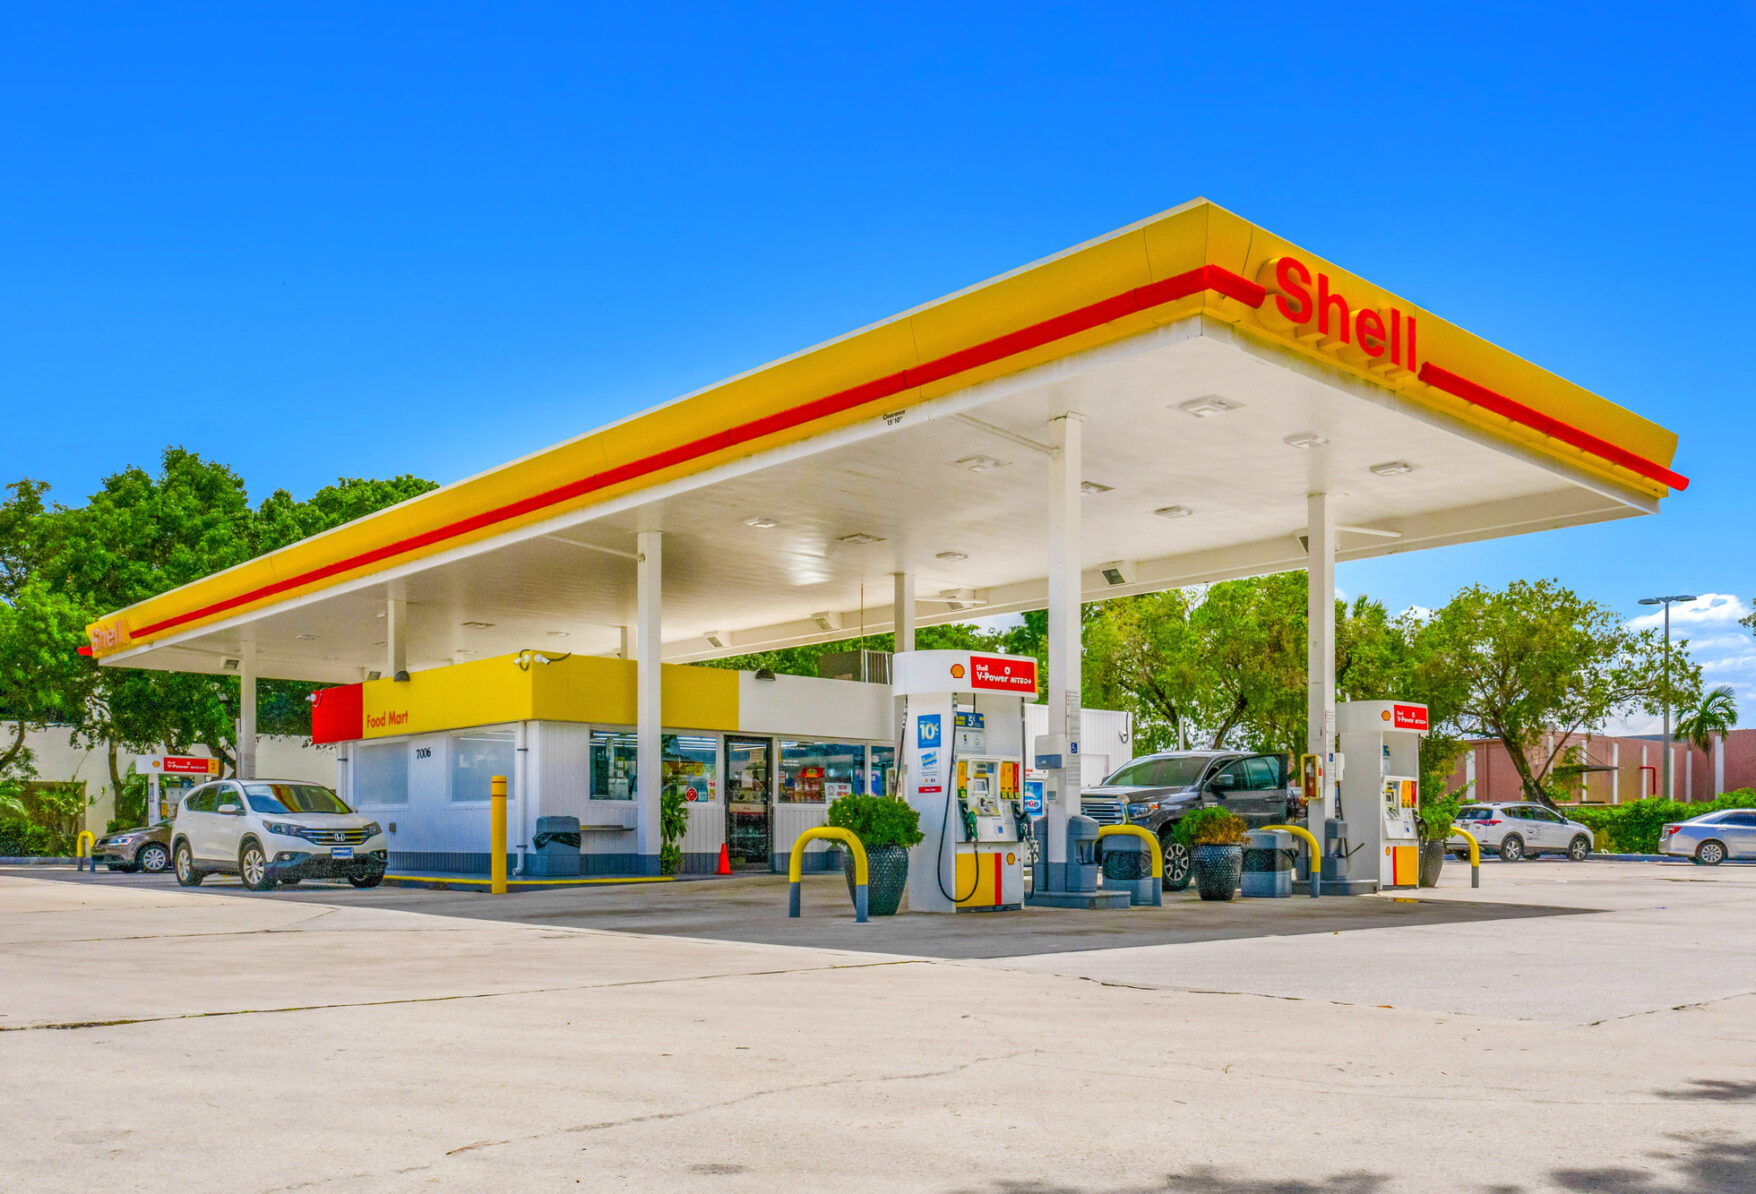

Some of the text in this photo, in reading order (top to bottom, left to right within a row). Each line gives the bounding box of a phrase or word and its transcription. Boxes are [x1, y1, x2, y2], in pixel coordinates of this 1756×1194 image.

[1275, 256, 1416, 373] Shell
[92, 619, 121, 652] Shell
[976, 664, 988, 672] Shell
[976, 671, 1008, 683] V-Power
[367, 710, 408, 729] Food Mart
[416, 747, 432, 760] 7006
